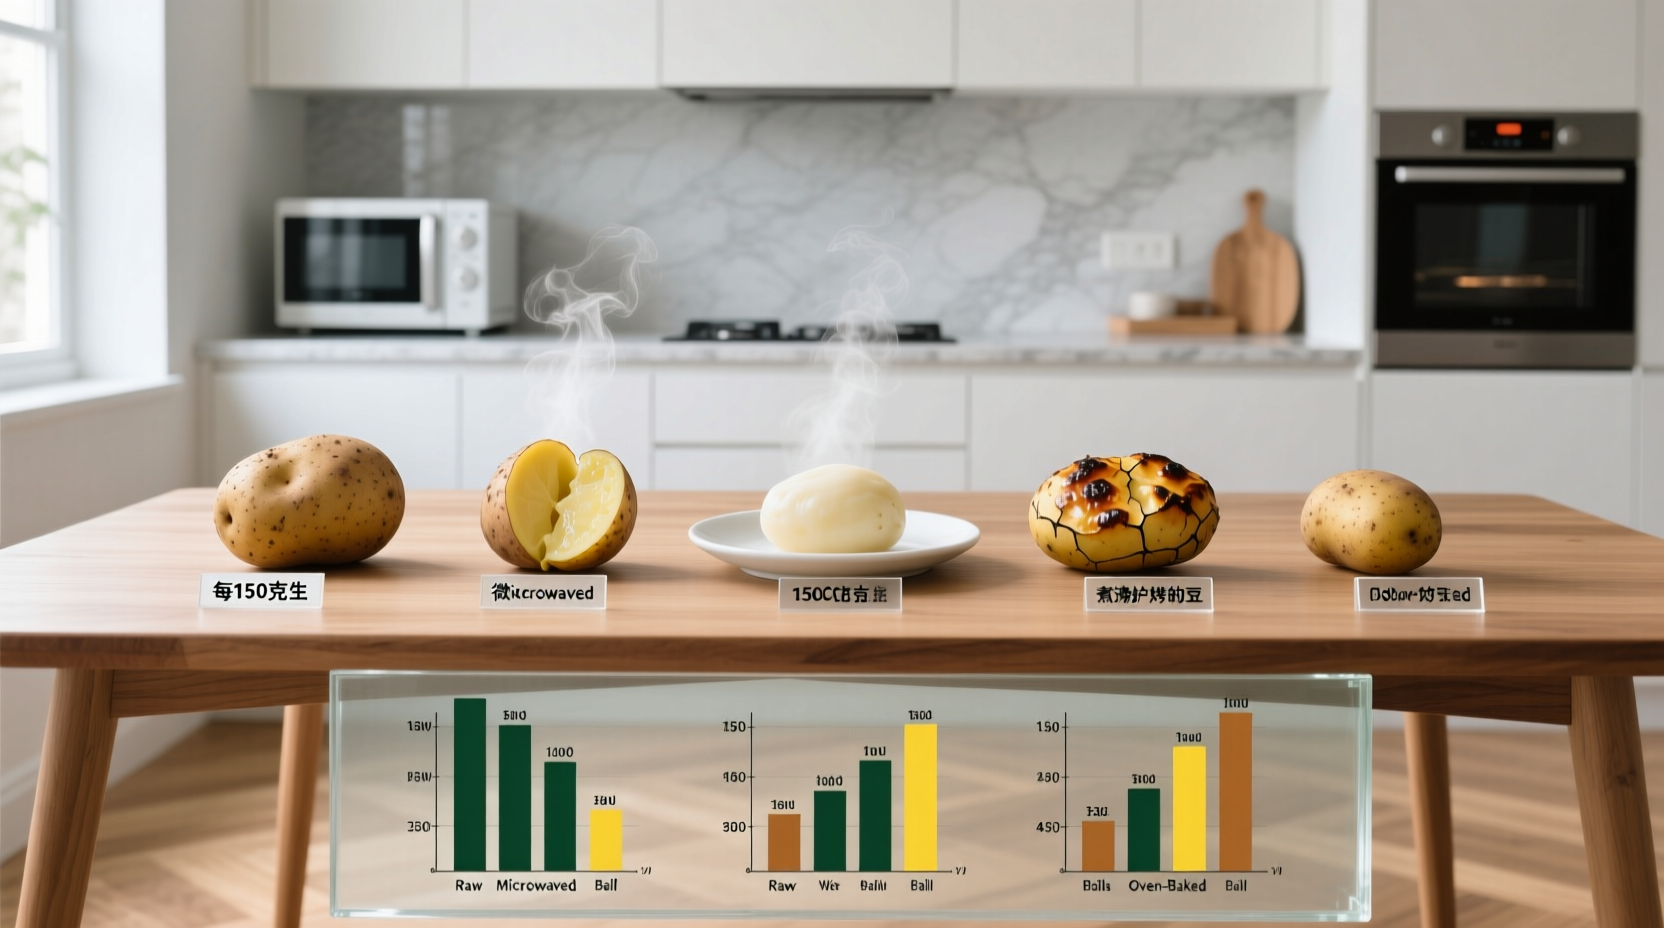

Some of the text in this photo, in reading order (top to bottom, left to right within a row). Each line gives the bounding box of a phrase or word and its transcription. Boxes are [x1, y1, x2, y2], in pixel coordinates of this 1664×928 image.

[212, 580, 308, 602] 每150克生
[722, 821, 747, 833] 300
[455, 879, 483, 892] Raw
[496, 878, 577, 892] Microwaved
[768, 879, 797, 892] Raw
[910, 878, 933, 892] Ball
[1128, 878, 1207, 892] Oven-Baked
